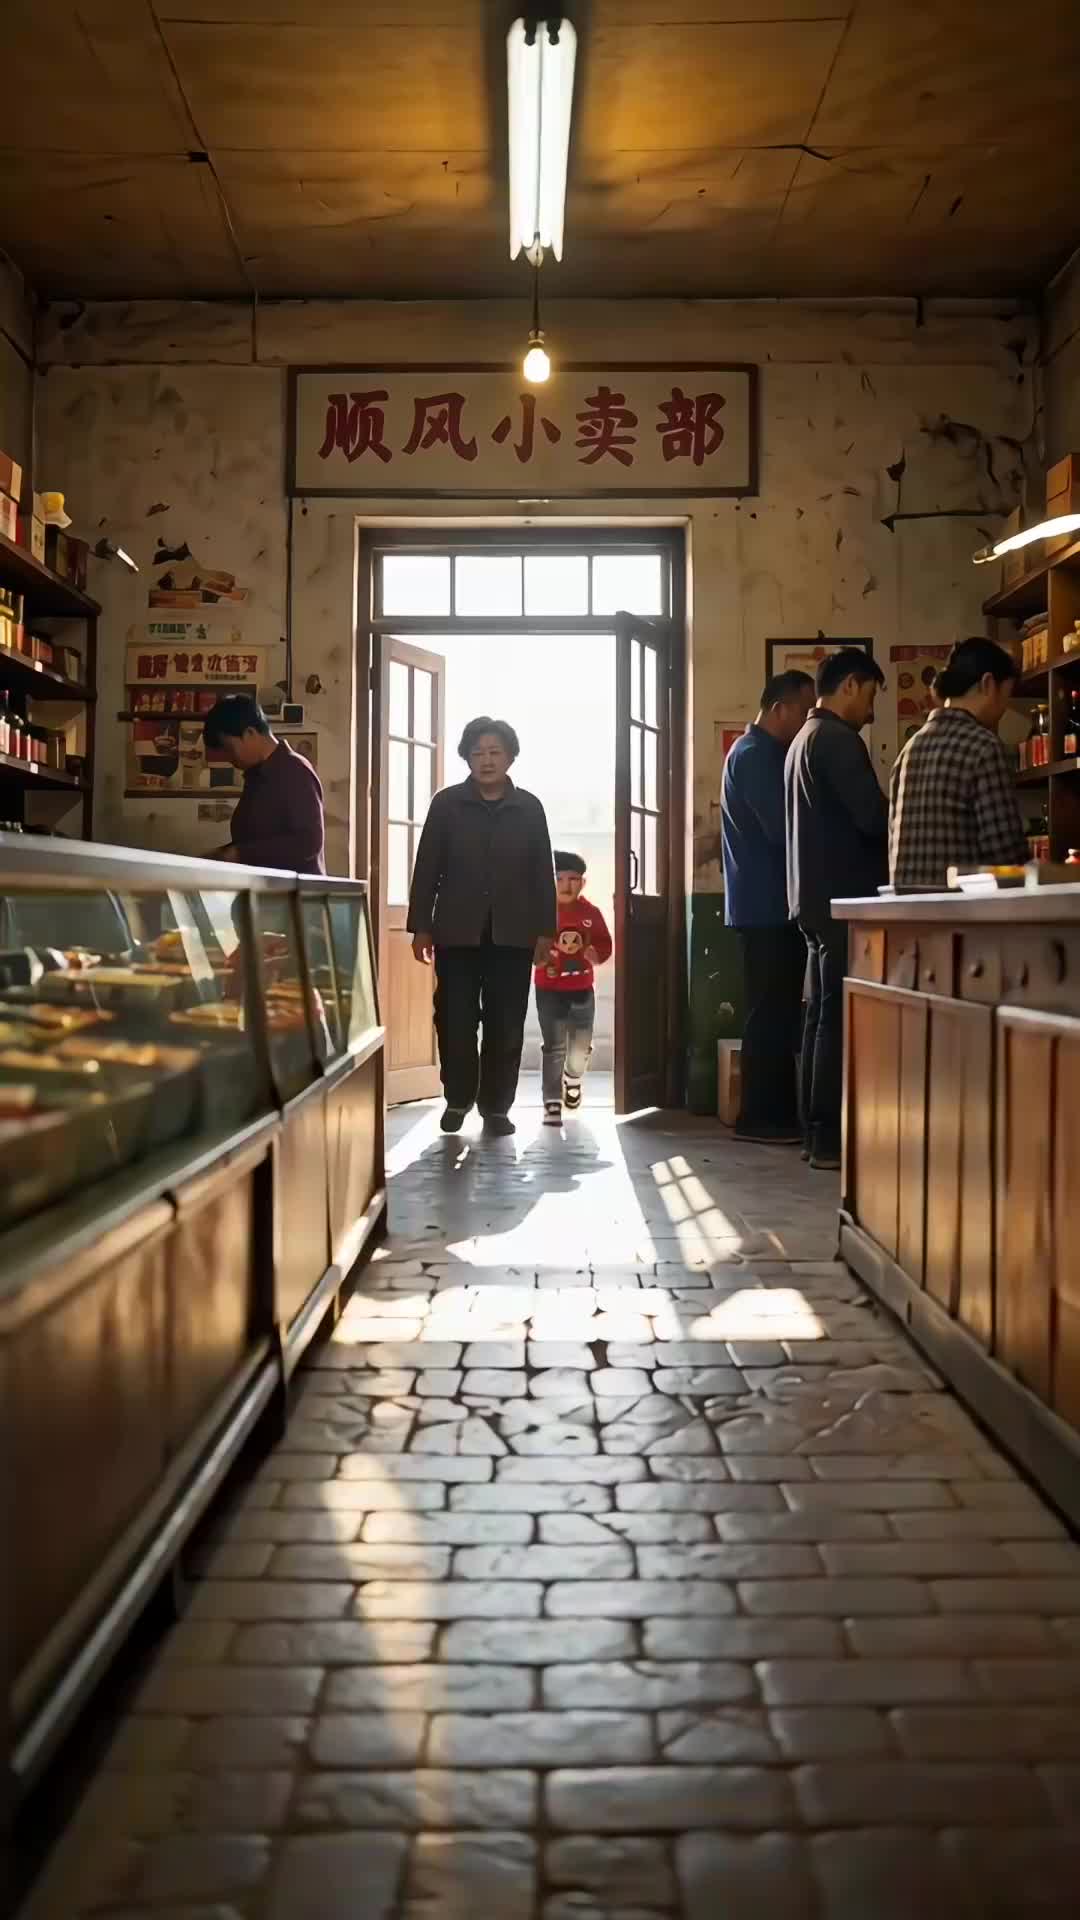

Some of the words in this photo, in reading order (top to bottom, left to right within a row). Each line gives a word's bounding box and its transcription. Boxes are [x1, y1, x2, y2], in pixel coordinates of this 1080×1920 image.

[318, 386, 726, 467] 顺风小卖部
